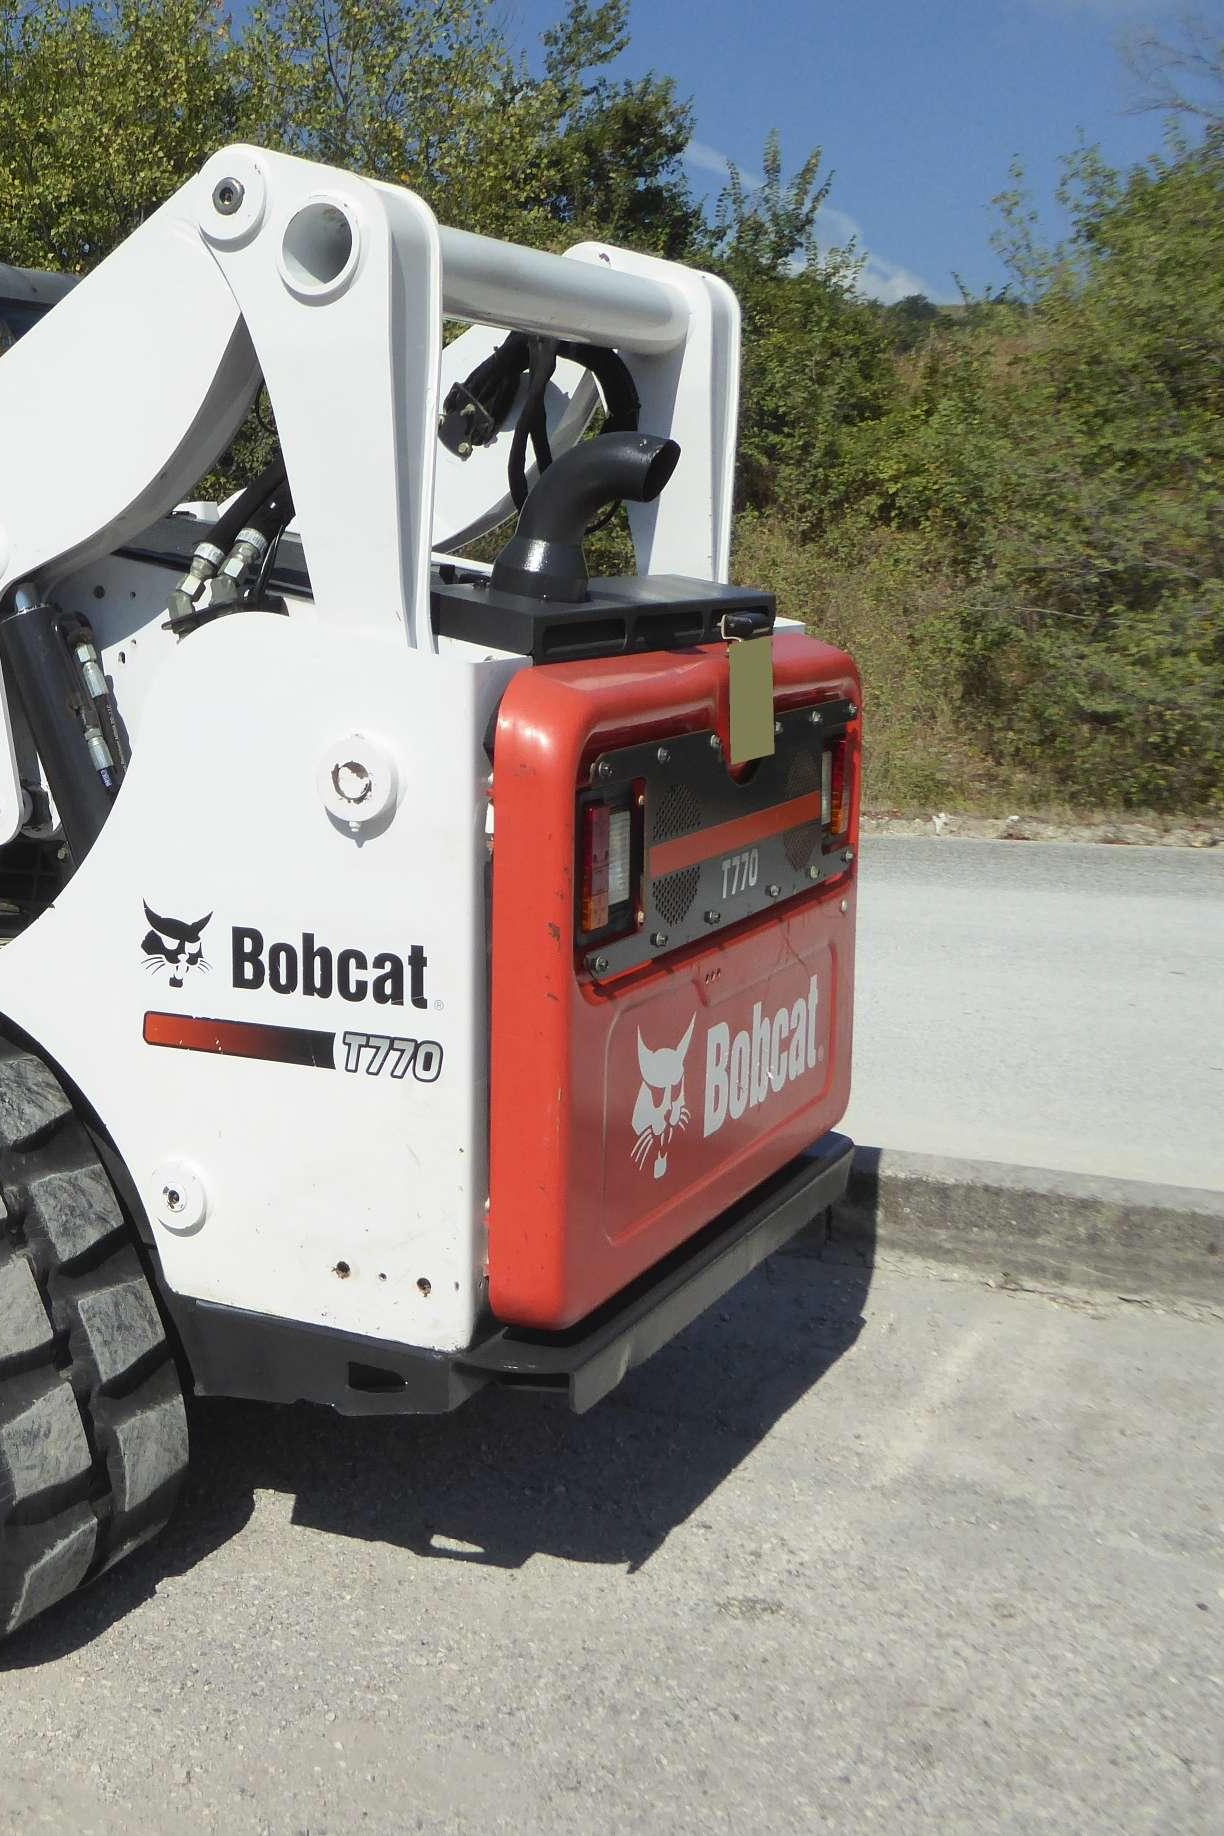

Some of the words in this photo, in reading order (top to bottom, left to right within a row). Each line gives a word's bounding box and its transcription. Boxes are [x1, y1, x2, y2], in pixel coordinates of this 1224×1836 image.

[722, 848, 758, 899] T770
[232, 926, 428, 1009] Bobcat
[343, 1031, 444, 1082] T770
[704, 974, 818, 1138] Bobcat
